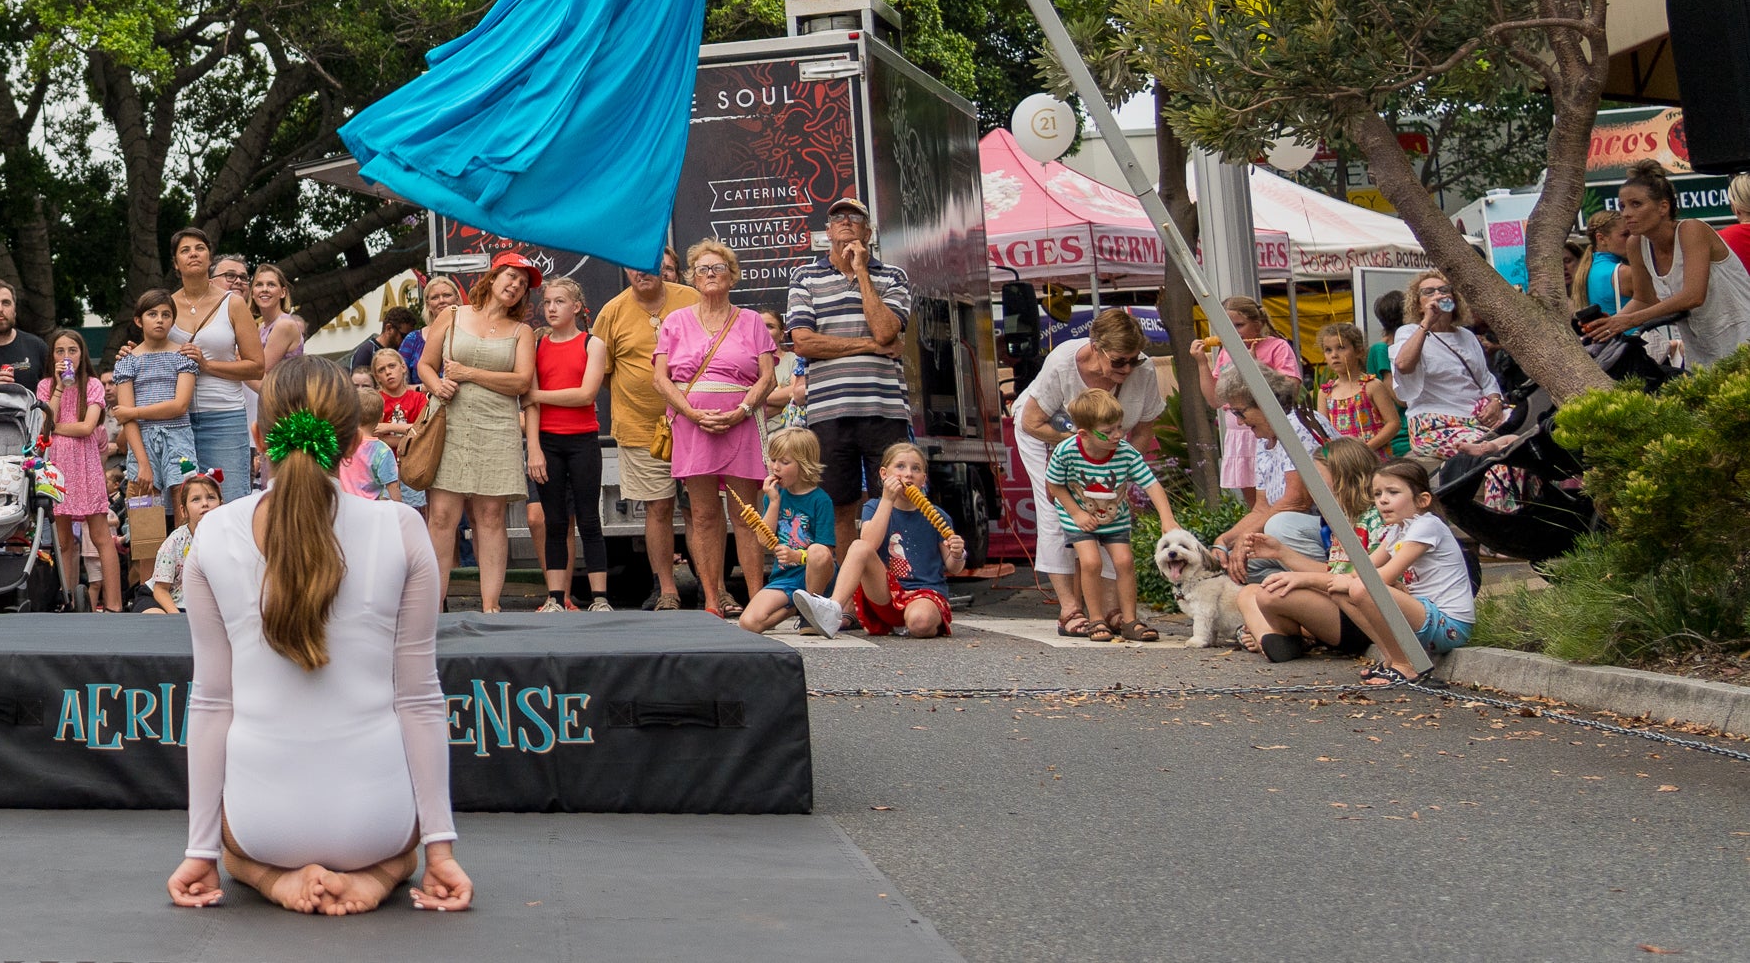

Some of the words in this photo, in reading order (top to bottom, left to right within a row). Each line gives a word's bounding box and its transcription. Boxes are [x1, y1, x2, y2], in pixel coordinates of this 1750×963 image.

[717, 85, 795, 111] SOUL
[723, 185, 798, 201] CATERING
[729, 220, 791, 235] PRIVATE
[720, 232, 807, 248] FUNCTIONS
